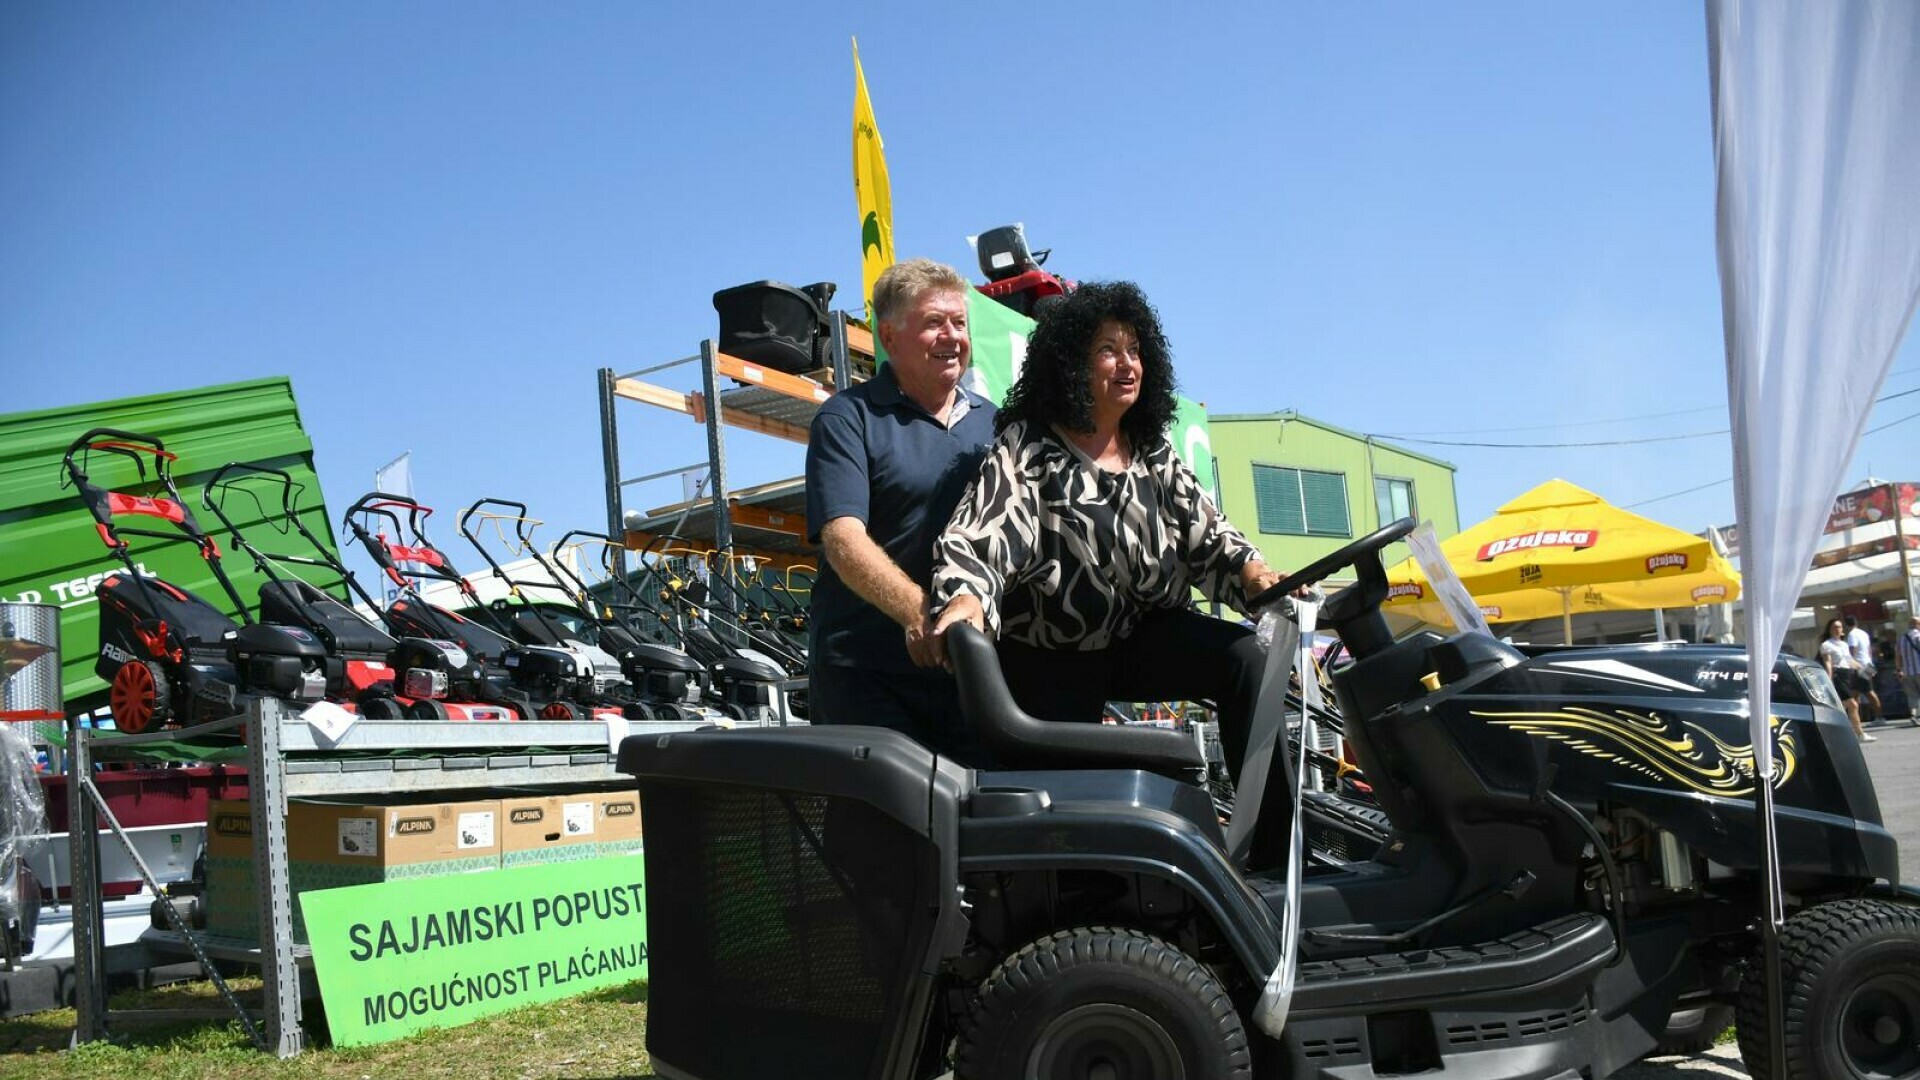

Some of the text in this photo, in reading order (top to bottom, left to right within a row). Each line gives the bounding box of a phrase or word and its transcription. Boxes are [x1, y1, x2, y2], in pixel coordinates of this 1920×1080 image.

[607, 804, 633, 814] ALPINA
[513, 810, 541, 821] ALPINA
[399, 820, 432, 832] ALPINA
[349, 883, 643, 962] SAJAMSKI POPUST
[364, 941, 649, 1026] MOGUĆNOST PLAĆANJA
